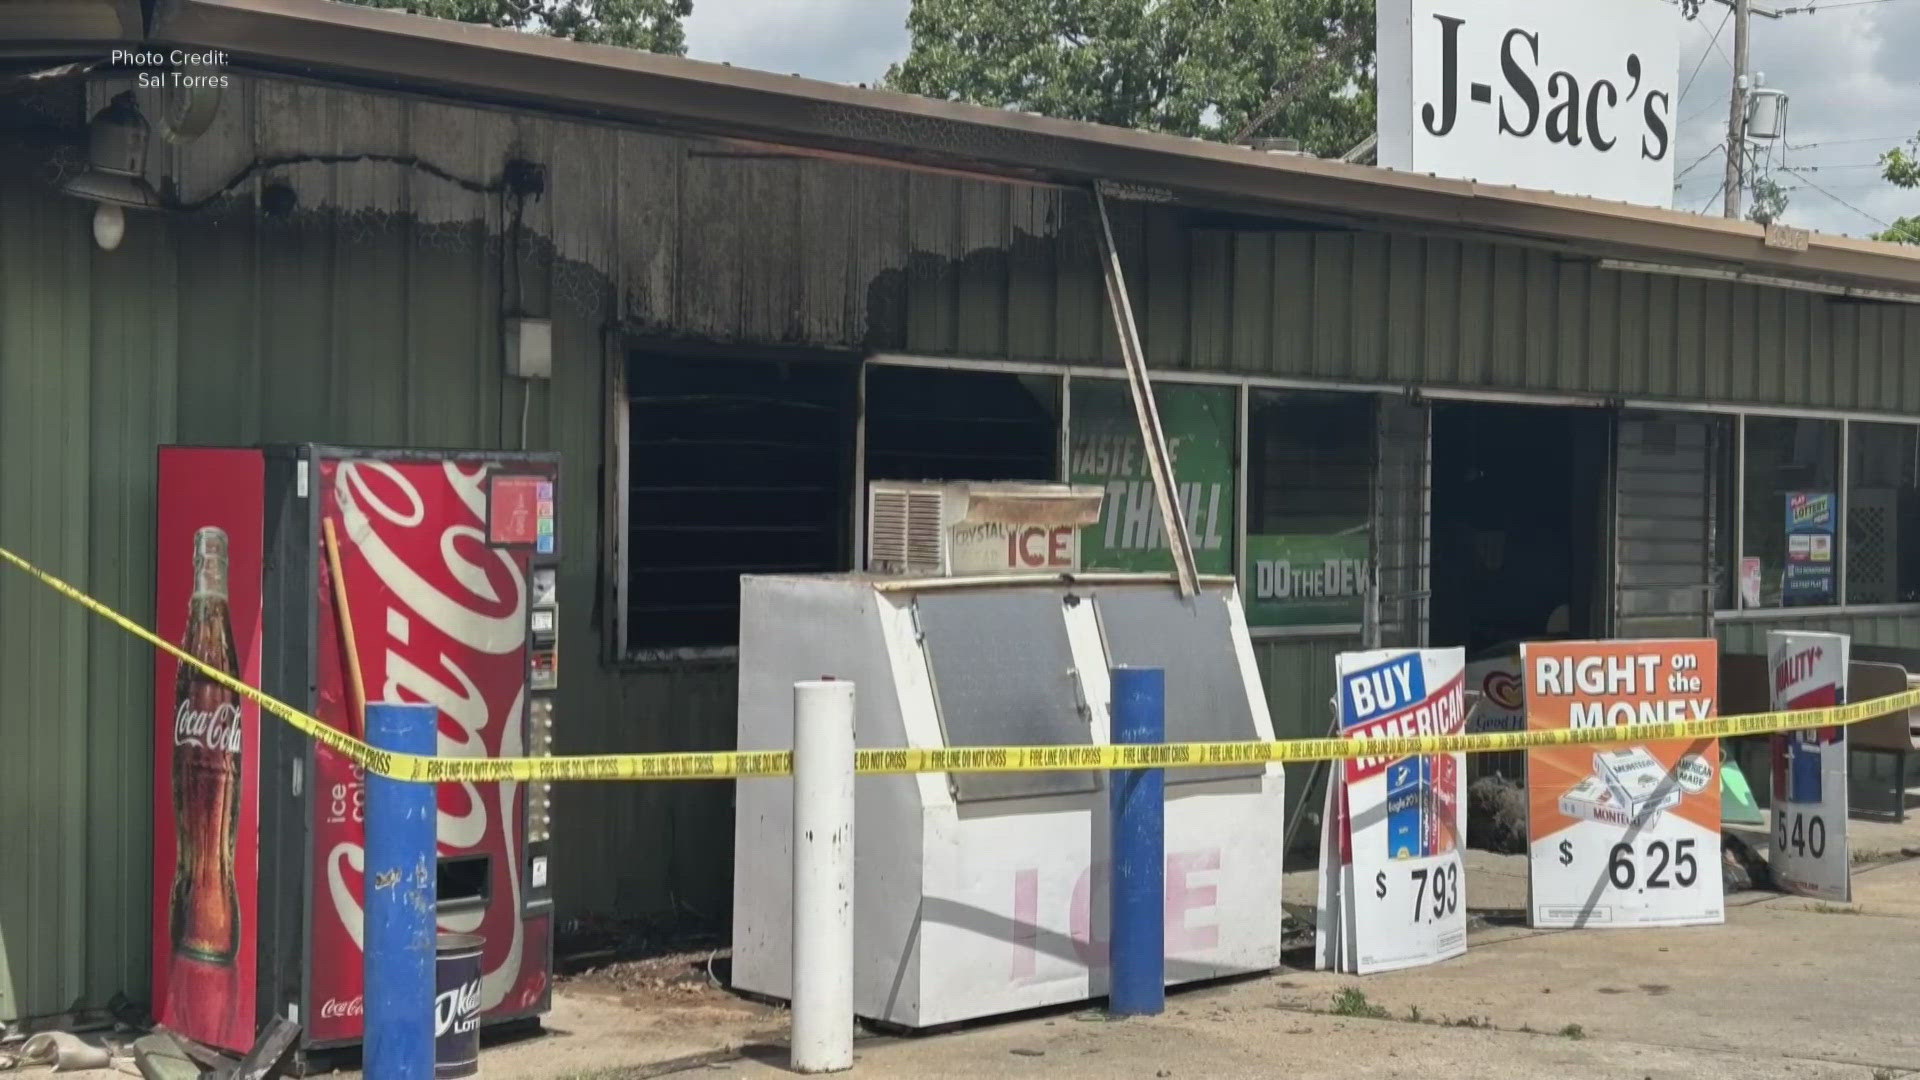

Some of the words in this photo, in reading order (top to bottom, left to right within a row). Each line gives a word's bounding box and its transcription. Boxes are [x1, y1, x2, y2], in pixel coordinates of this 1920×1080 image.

[1422, 13, 1669, 161] J-Sac's
[1793, 499, 1827, 521] LOTTERY
[1008, 526, 1073, 569] ICE
[1256, 559, 1291, 599] DO
[1291, 568, 1324, 598] THE
[1536, 653, 1660, 695] RIGHT
[1671, 653, 1697, 670] on
[1350, 660, 1412, 718] BUY
[1668, 672, 1701, 693] the
[1352, 680, 1465, 771] AMERICAN
[1570, 698, 1712, 732] MONEY
[860, 751, 869, 770] DO
[870, 751, 883, 770] NOT
[885, 751, 907, 770] CROSS
[931, 750, 945, 769] FIRE
[946, 750, 960, 769] LINE
[961, 750, 971, 769] DO
[972, 749, 985, 768] NOT
[986, 749, 1007, 768] CROSS
[1029, 749, 1043, 767] FIRE
[1044, 749, 1058, 767] LINE
[1059, 749, 1068, 767] DO
[1069, 748, 1081, 766] NOT
[1082, 748, 1101, 766] CROSS
[1123, 747, 1136, 764] FIRE
[1137, 746, 1150, 763] LINE
[1151, 746, 1159, 763] DO
[1160, 746, 1171, 763] NOT
[1172, 745, 1190, 762] CROSS
[326, 783, 347, 823] ice
[1558, 838, 1574, 867] $
[1609, 838, 1698, 894] 6.25
[1375, 869, 1387, 900] $
[1411, 862, 1458, 925] 7.93
